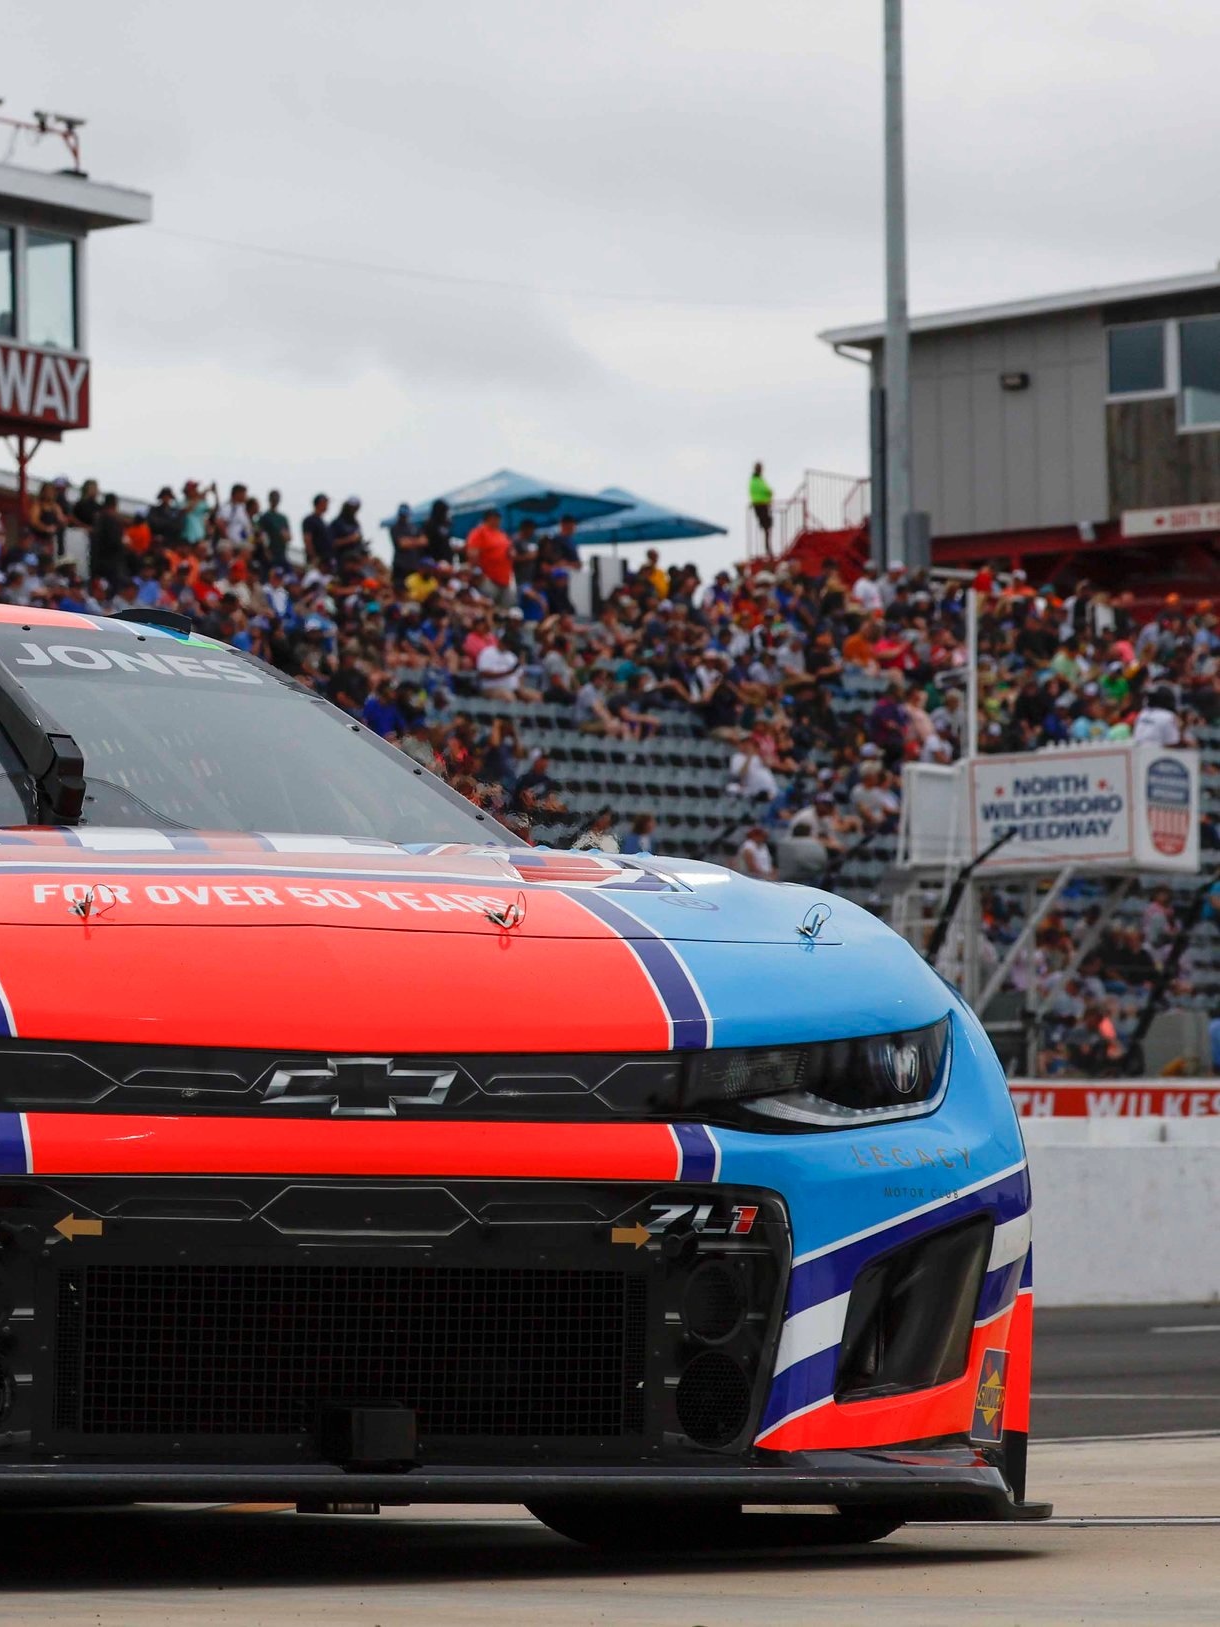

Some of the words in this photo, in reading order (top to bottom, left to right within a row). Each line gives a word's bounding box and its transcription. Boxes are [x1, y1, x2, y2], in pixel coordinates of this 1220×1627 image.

[15, 642, 264, 685] JONES
[1013, 774, 1089, 796] NORTH
[982, 795, 1123, 822] WILKESBORO
[992, 818, 1113, 842] SPEEDWAY
[33, 884, 132, 904] FOR
[144, 885, 285, 906] OVER
[285, 887, 362, 909] 50
[358, 890, 525, 916] YEARS
[851, 1145, 970, 1169] LEGACY
[884, 1187, 925, 1199] MOTOR
[930, 1189, 959, 1199] CLUB
[644, 1205, 759, 1234] ZL1
